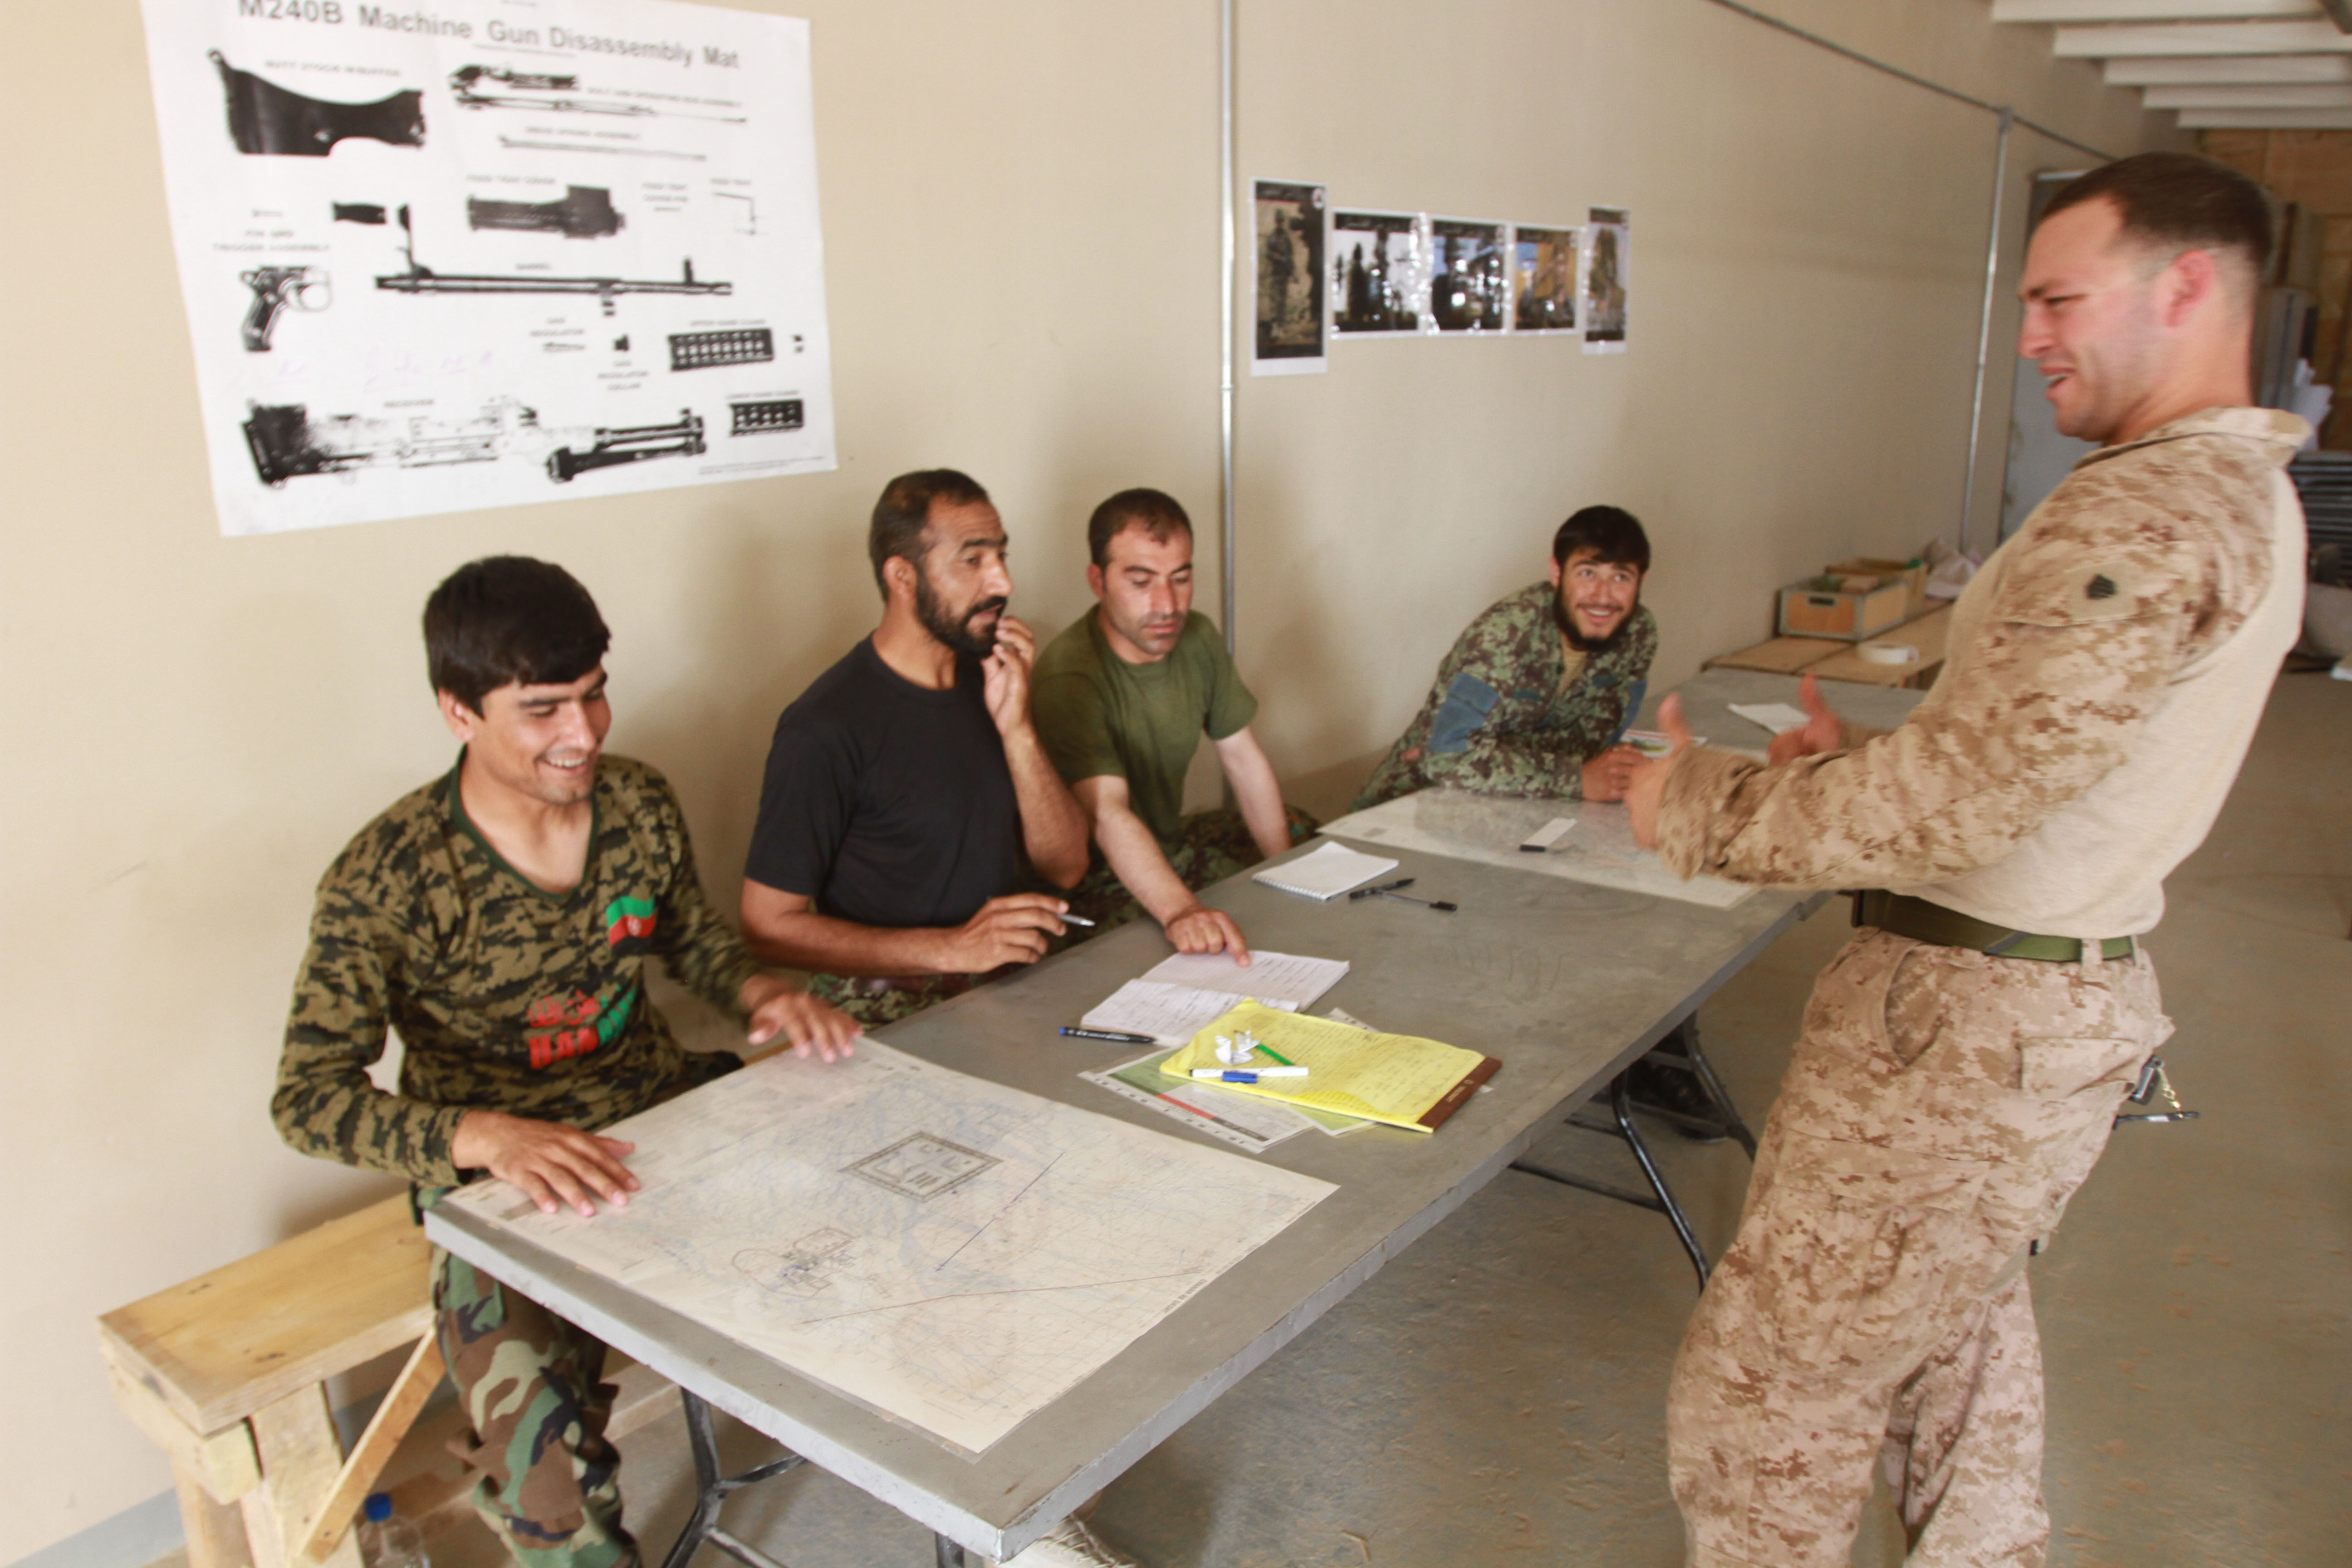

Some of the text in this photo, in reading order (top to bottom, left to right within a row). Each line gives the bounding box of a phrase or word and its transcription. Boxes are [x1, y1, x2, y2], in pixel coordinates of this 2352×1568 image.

[239, 0, 343, 23] M240B
[358, 6, 472, 38] Machine
[487, 20, 540, 44] Gun
[549, 27, 693, 68] Disassembly
[703, 46, 740, 68] Mat
